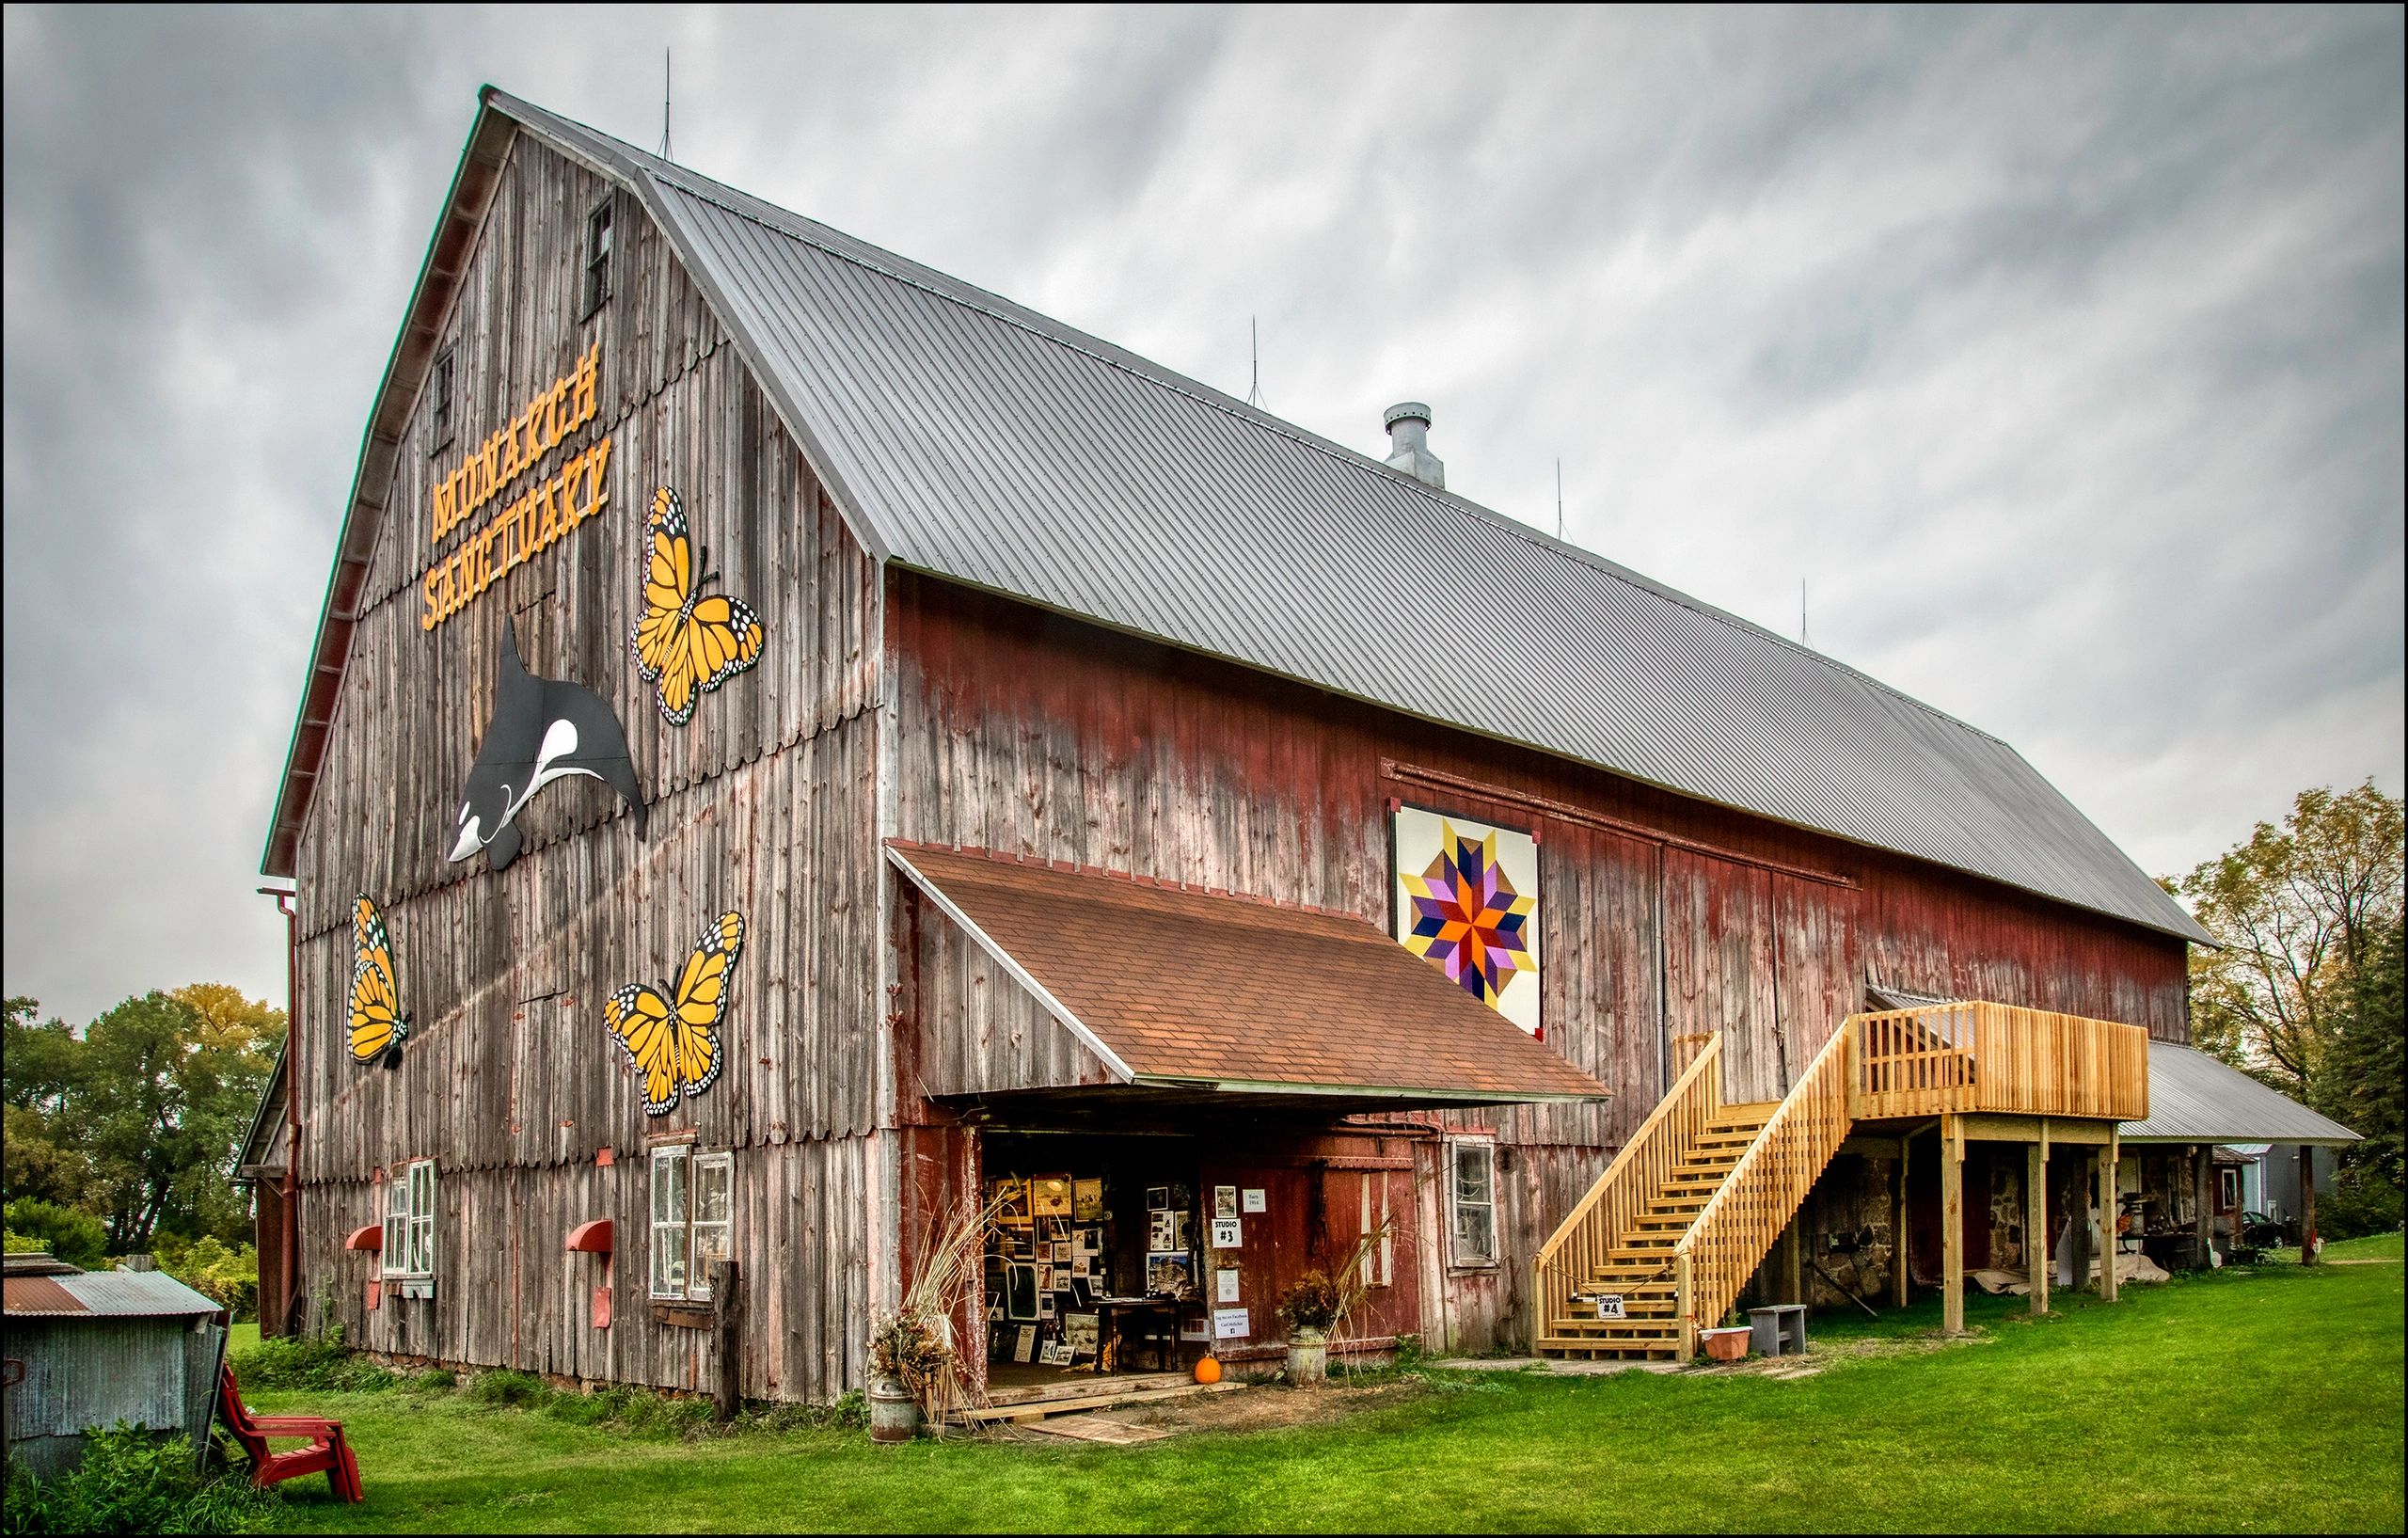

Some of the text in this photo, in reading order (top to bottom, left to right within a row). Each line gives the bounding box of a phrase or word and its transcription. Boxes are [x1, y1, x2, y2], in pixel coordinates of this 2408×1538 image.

[432, 341, 599, 544] MONARCH
[421, 437, 611, 631] SANCTUARY
[1220, 1230, 1233, 1243] #3
[1604, 1304, 1618, 1314] #4
